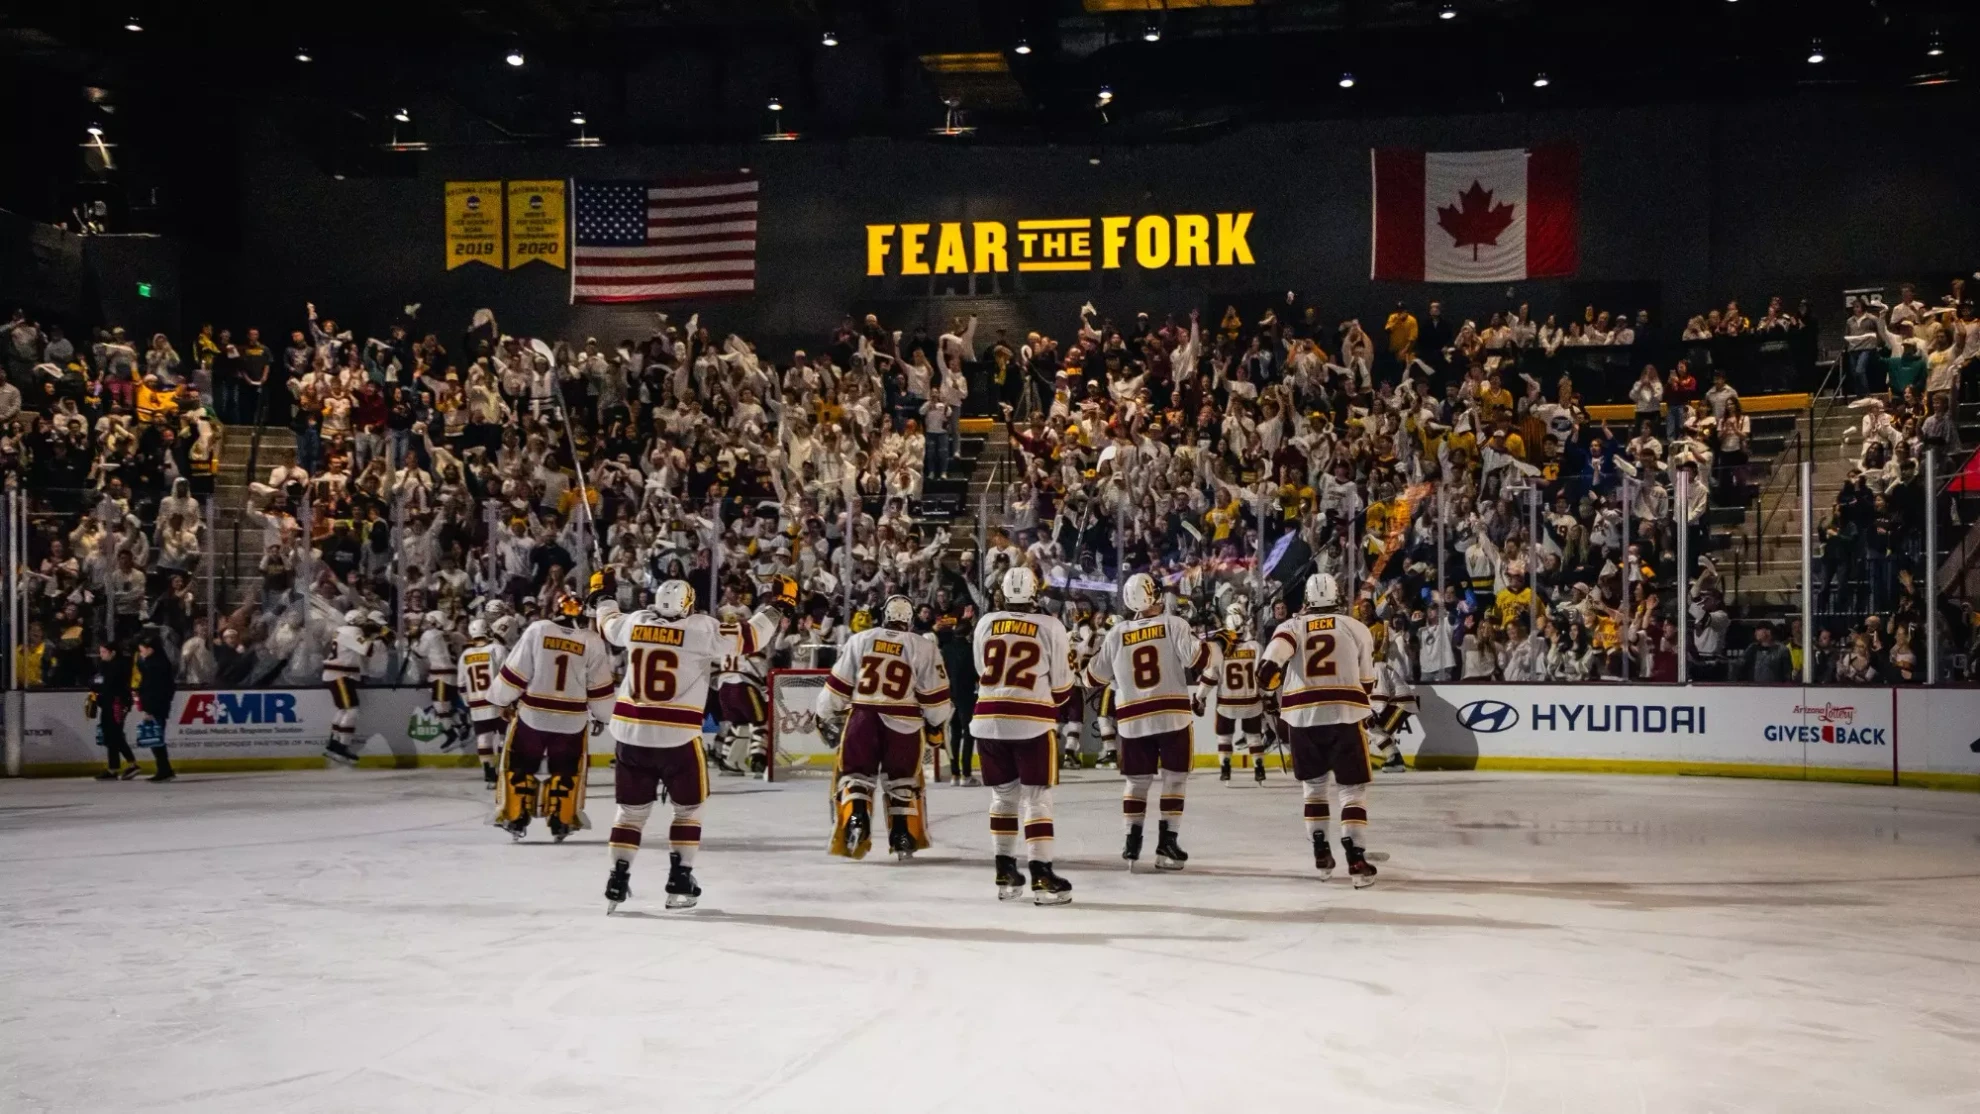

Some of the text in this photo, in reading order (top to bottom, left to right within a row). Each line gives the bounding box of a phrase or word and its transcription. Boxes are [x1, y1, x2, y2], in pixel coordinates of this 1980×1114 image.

[455, 242, 494, 255] 2019
[517, 242, 559, 255] 2020
[866, 212, 1256, 276] FEAR THE FORK
[631, 626, 684, 646] SZMAGAJ
[993, 620, 1037, 637] KIRWAN
[1308, 618, 1333, 631] BECK
[981, 639, 1041, 691] 92
[1132, 645, 1161, 689] 8
[1306, 634, 1336, 677] 2
[467, 664, 491, 692] 15
[554, 654, 569, 691] 1
[630, 648, 679, 701] 16
[858, 656, 912, 700] 39
[1226, 662, 1254, 690] 61
[179, 692, 297, 725] AMR
[1532, 704, 1706, 734] HYUNDAI
[1793, 702, 1856, 725] Arizona Lottery
[210, 727, 238, 735] Medical
[1764, 725, 1886, 745] GIVES BACK
